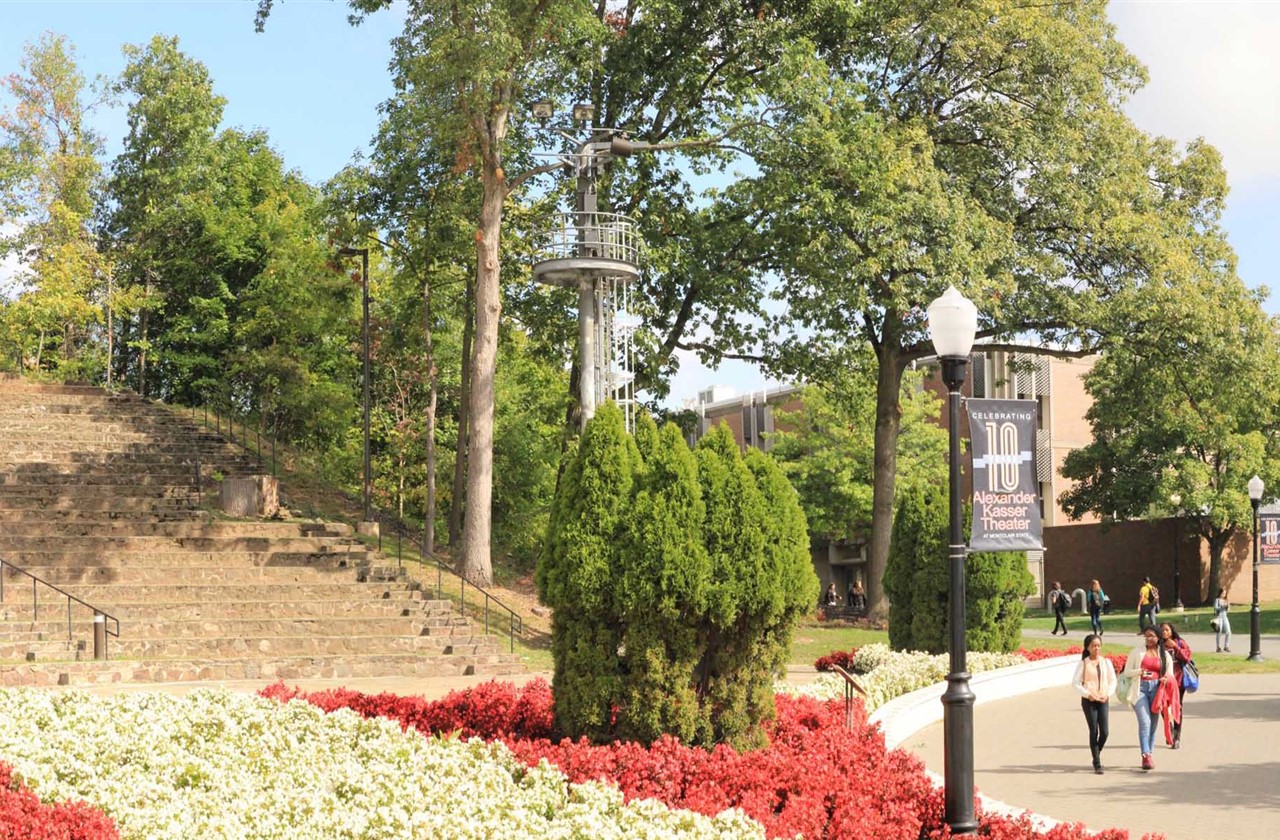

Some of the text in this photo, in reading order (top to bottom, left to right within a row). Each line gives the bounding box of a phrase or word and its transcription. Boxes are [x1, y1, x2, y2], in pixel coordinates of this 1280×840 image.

[972, 412, 1032, 420] CELEBRATING
[985, 422, 1020, 491] 10
[973, 491, 1036, 504] Alexander
[982, 504, 1028, 517] Kasser
[980, 517, 1031, 530] Theater
